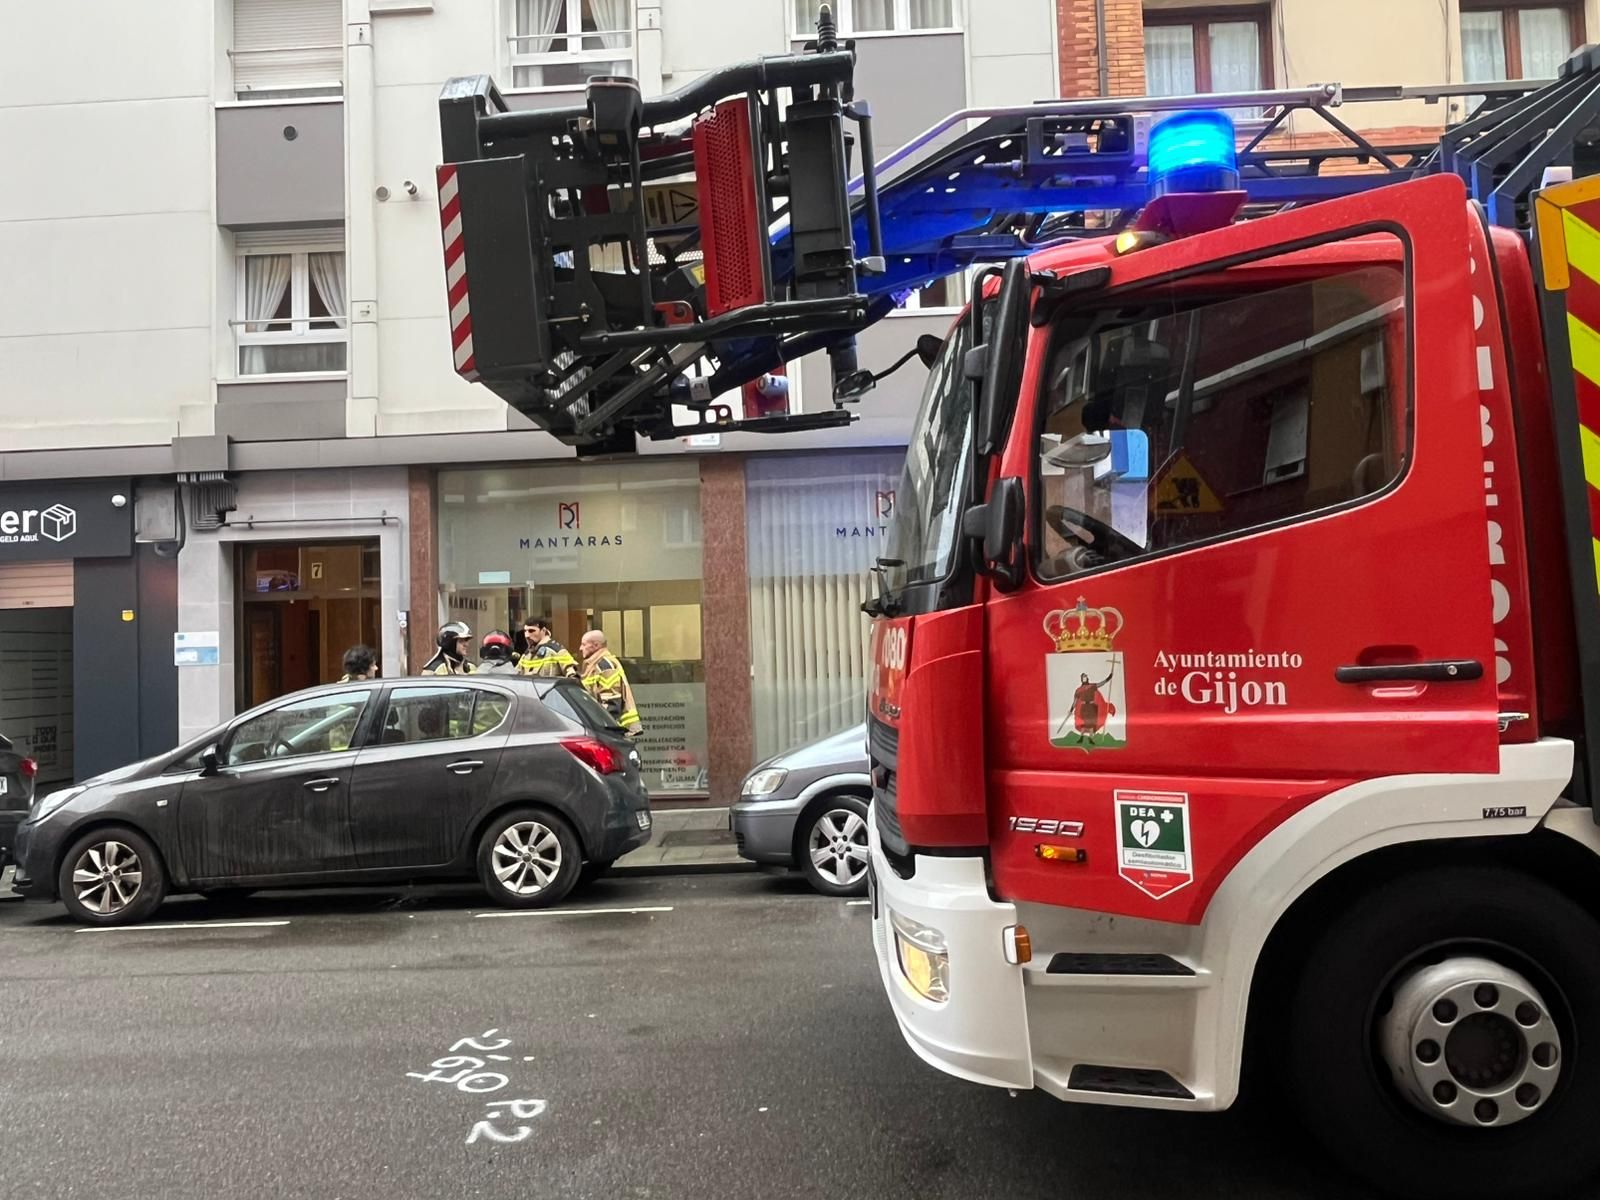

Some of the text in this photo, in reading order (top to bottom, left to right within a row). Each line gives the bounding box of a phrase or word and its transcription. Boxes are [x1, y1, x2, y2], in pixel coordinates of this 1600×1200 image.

[836, 526, 887, 538] MANT
[520, 535, 623, 549] MANTARAS
[312, 563, 321, 578] 7
[1154, 649, 1303, 673] Ayuntamiento
[1154, 671, 1288, 714] de Gijon
[1129, 806, 1157, 818] DEA
[1507, 807, 1525, 817] bar
[1009, 816, 1085, 837] 1530
